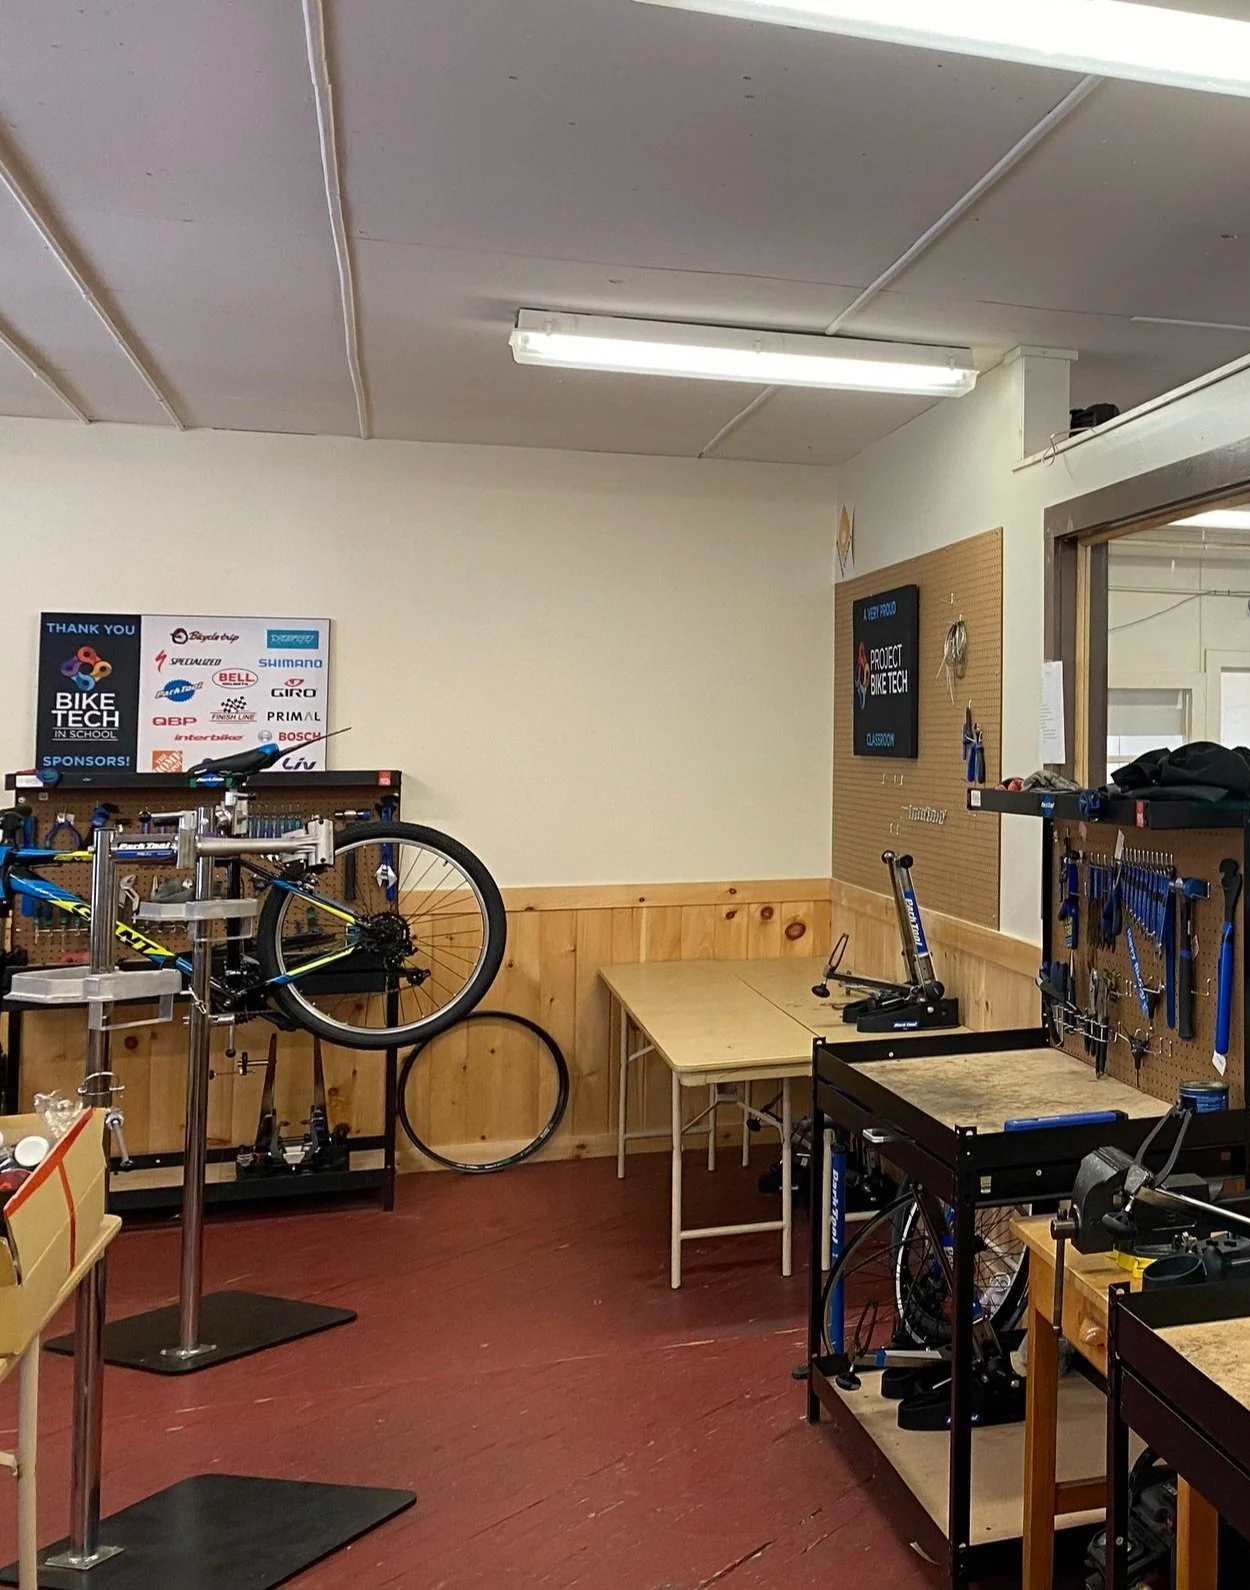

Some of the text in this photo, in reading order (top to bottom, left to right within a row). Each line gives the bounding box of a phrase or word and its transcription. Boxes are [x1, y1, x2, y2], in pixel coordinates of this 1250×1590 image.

[46, 622, 135, 635] THANK YOU
[169, 658, 222, 667] SPECIALIZED
[870, 644, 903, 671] PROJECT
[258, 658, 323, 669] SHIMANO
[219, 672, 254, 682] BELL
[870, 669, 908, 696] BIKE TECH
[271, 688, 317, 698] GIRO
[56, 692, 116, 710] BIKE
[51, 710, 119, 728] TECH
[152, 716, 197, 727] QBP
[54, 729, 117, 739] IN SCHOOL
[174, 733, 244, 742] interbike
[278, 731, 322, 742] BOSCH
[42, 755, 130, 767] SPONSORS!
[282, 756, 317, 770] Liv
